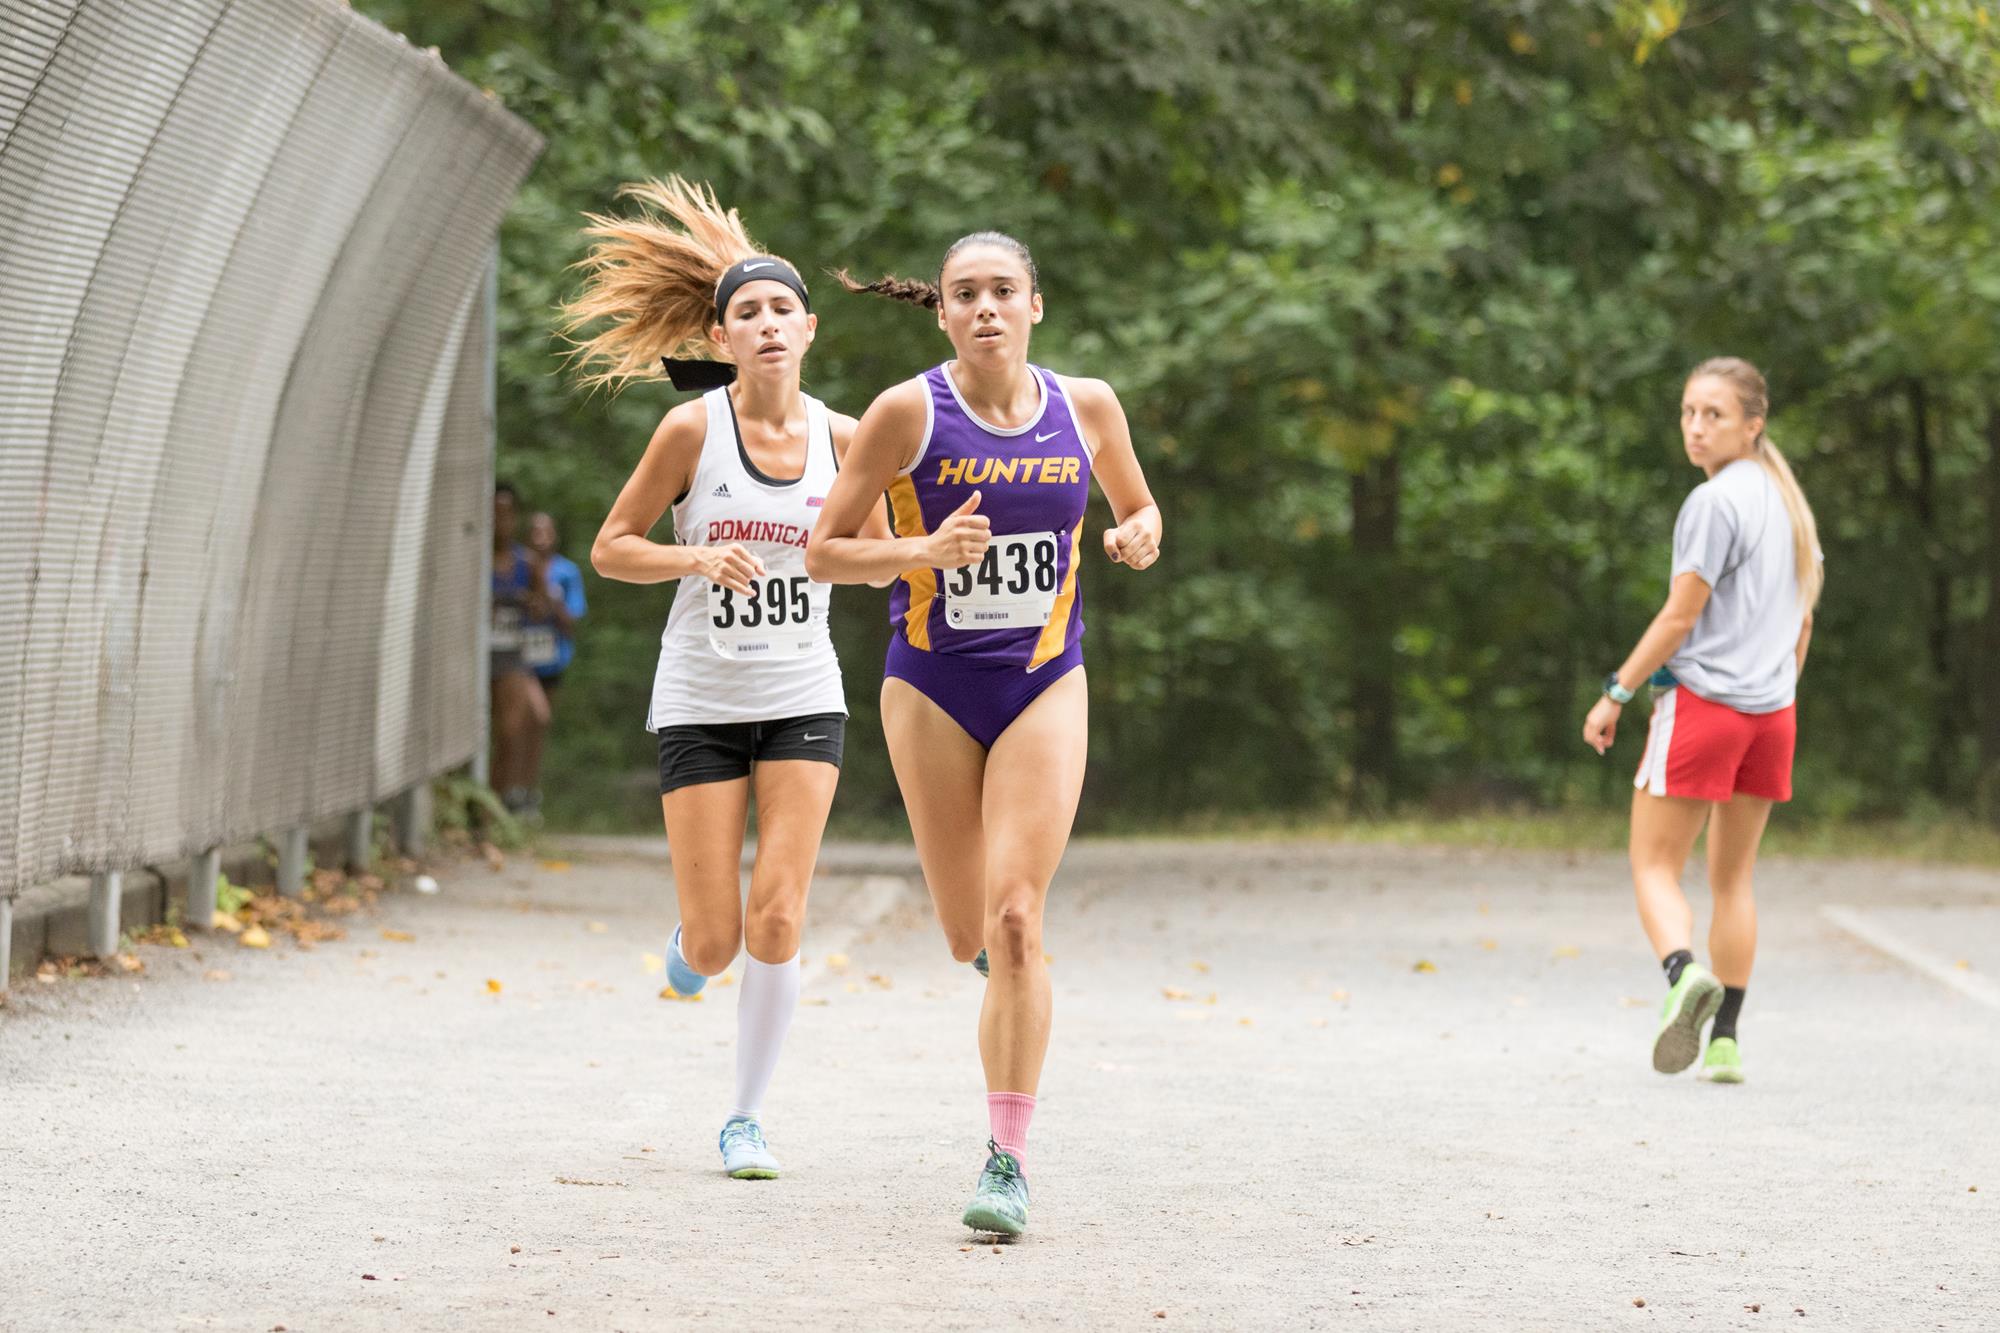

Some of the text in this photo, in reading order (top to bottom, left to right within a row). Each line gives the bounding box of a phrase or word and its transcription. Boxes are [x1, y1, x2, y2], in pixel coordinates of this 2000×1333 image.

[936, 457, 1081, 485] HUNTER
[948, 540, 1056, 597] 3438
[711, 576, 810, 629] 3395
